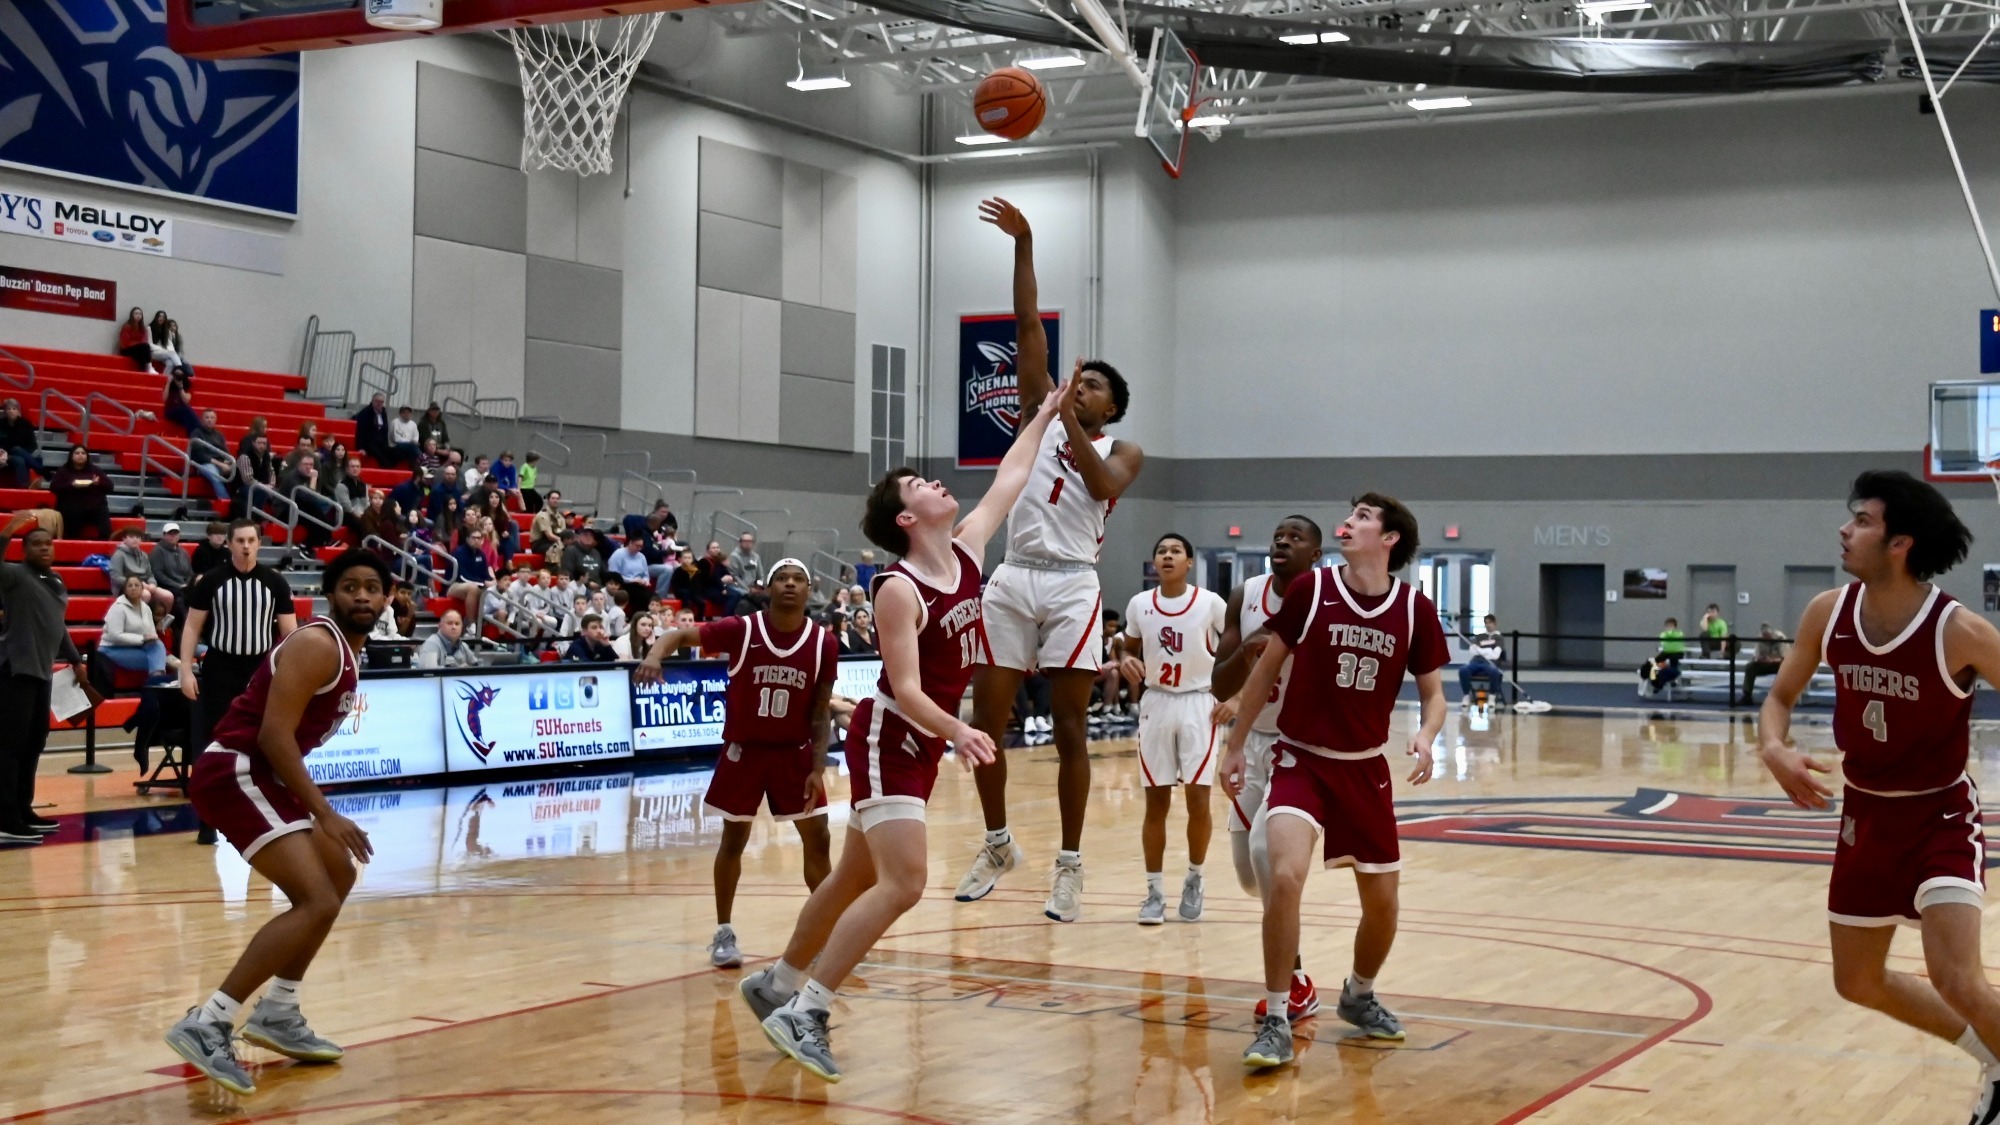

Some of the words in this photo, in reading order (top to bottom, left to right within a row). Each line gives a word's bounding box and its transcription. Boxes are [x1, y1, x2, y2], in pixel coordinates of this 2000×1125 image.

[0, 193, 42, 230] Y'S
[66, 227, 88, 236] TOYOTA
[0, 275, 33, 291] Buzzin'
[35, 281, 63, 295] Dozen
[65, 285, 82, 300] Pep
[83, 287, 106, 300] Band
[970, 375, 1018, 406] SHENAN
[985, 396, 1020, 409] HORNE
[1048, 477, 1064, 505] 1
[1533, 524, 1611, 546] MEN'S
[960, 627, 976, 669] 11
[1160, 626, 1183, 652] SU
[1328, 624, 1396, 658] TIGERS
[752, 665, 807, 689] TIGERS
[847, 669, 879, 681] ULTIM
[1159, 663, 1182, 687] 21
[1336, 652, 1379, 691] 32
[1838, 664, 1919, 701] TIGERS
[661, 680, 698, 696] Buying?
[701, 679, 726, 692] Think
[841, 685, 874, 697] AUTOM
[636, 695, 695, 726] Think
[700, 695, 725, 723] La
[757, 687, 790, 718] 10
[1862, 700, 1887, 742] 4
[503, 741, 630, 762] www.SUHornets.com
[308, 758, 402, 781] ORYDAYSGRILL.COM
